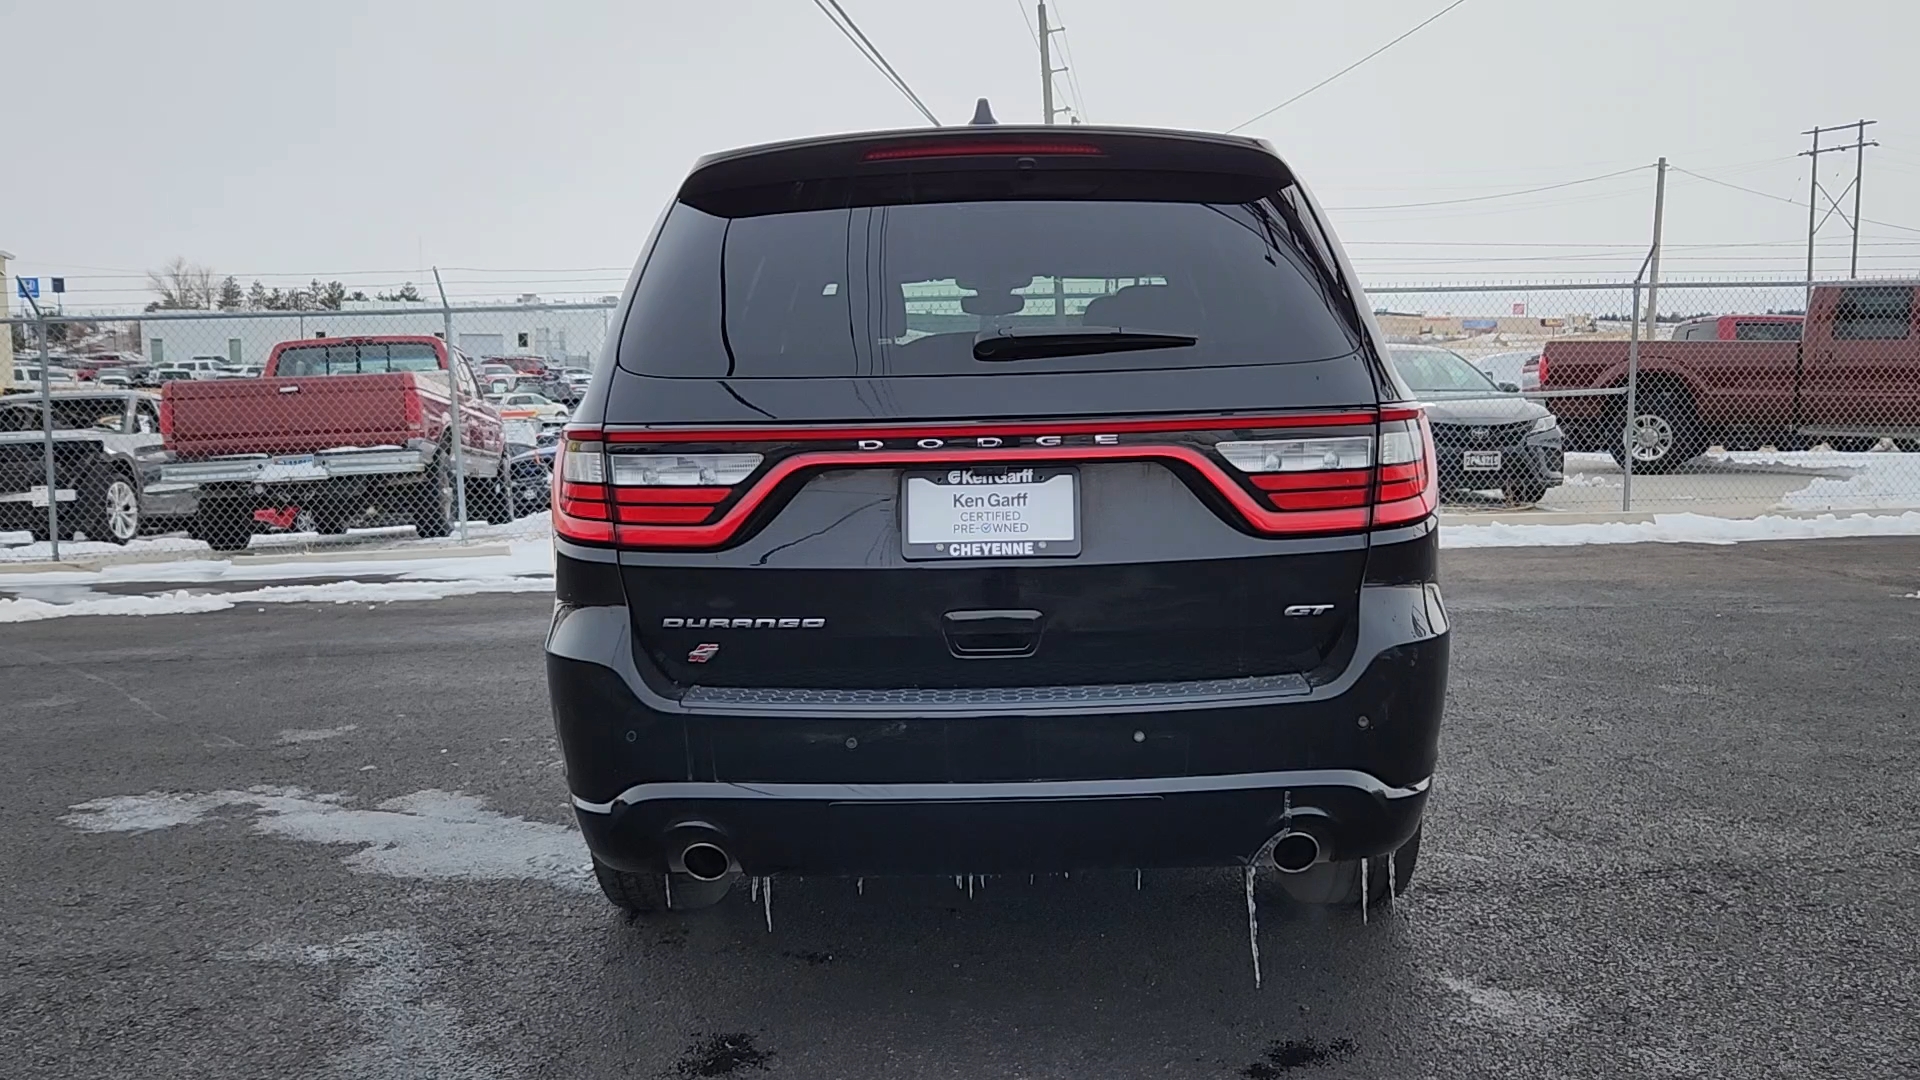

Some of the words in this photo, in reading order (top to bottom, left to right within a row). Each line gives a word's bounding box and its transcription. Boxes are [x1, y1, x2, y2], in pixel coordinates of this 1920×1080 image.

[858, 434, 1119, 450] DODGE
[953, 493, 985, 508] Ken
[988, 492, 1028, 507] Garff
[960, 511, 1021, 522] CERTIFIED
[949, 542, 1035, 556] CHEYENNE
[1284, 604, 1335, 616] GT
[662, 618, 826, 628] DURANGO
